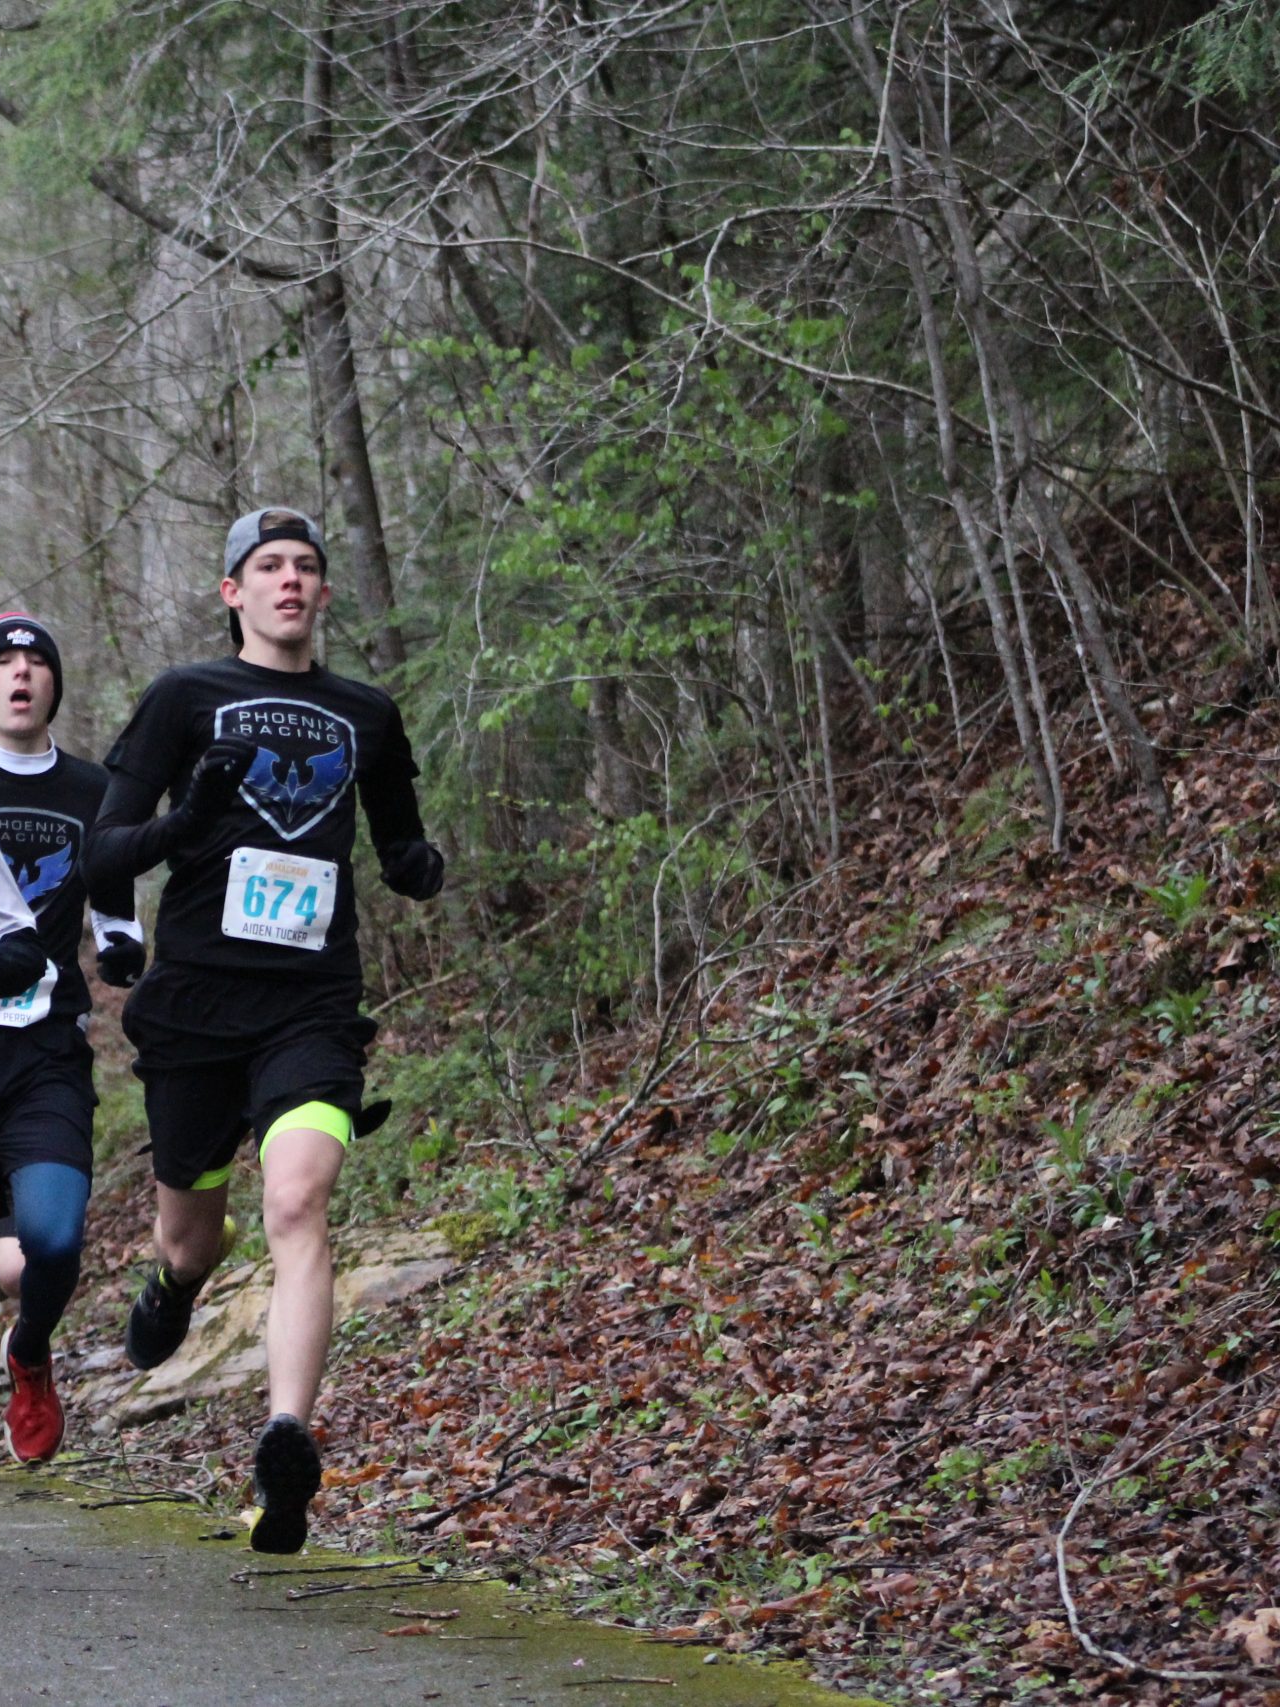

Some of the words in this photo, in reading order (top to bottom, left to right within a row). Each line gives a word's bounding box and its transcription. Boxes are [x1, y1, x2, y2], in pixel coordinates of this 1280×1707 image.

[239, 711, 336, 732] PHOENIX
[240, 724, 338, 743] RACING
[243, 875, 318, 927] 674
[241, 922, 273, 938] AIDEN
[276, 926, 309, 943] TUCKER
[3, 1012, 33, 1023] PERRY
